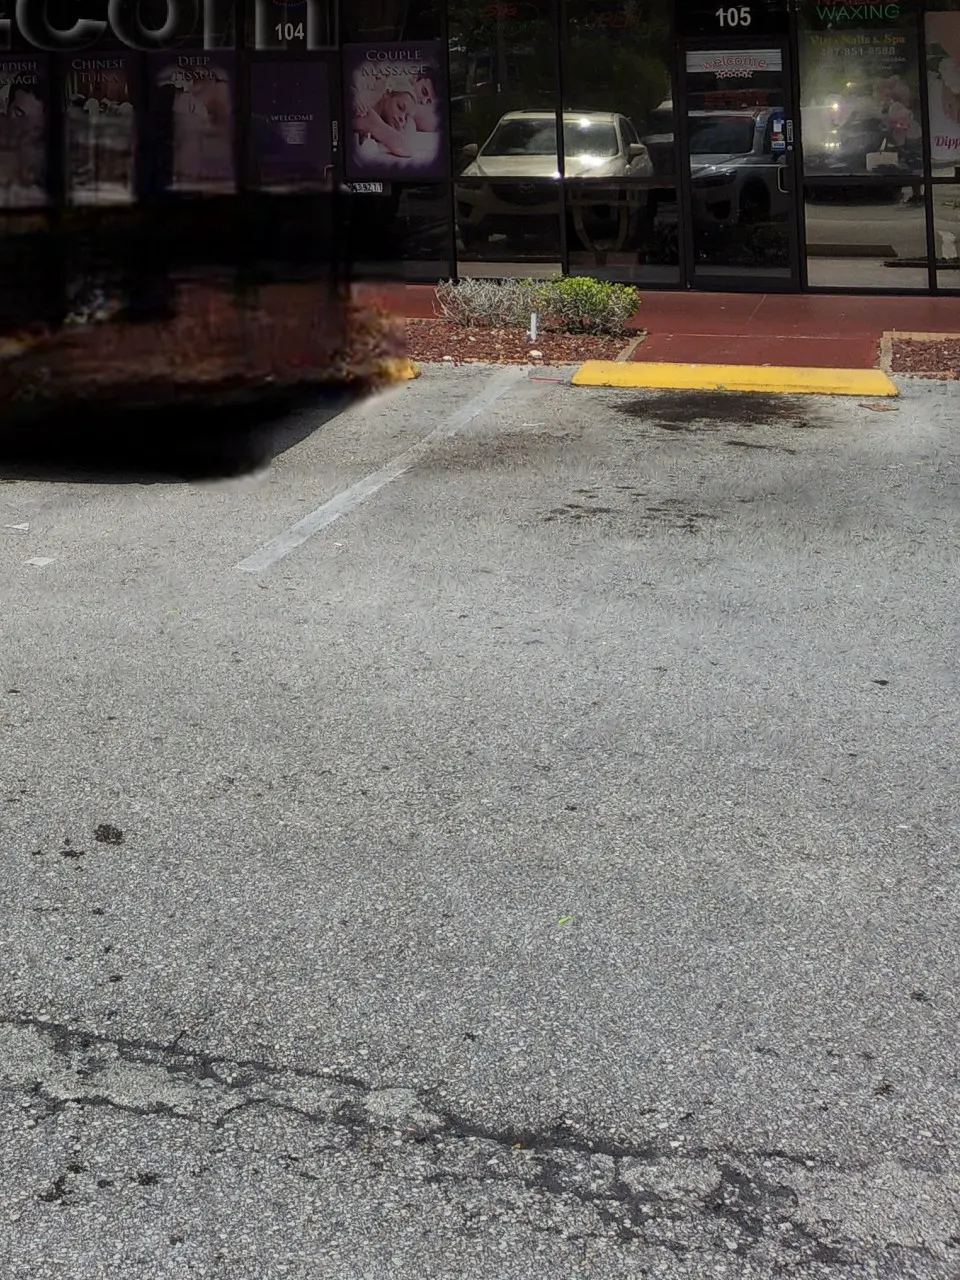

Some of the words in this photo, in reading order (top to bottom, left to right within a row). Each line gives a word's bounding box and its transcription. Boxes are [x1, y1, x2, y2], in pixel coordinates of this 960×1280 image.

[715, 7, 752, 27] 105
[816, 4, 900, 21] WAXING
[275, 22, 305, 41] 104
[883, 33, 906, 46] Spa
[178, 56, 210, 67] DEEP
[365, 49, 422, 62] COUPLE
[71, 59, 126, 70] CHINESE
[701, 55, 769, 70] welcome
[270, 113, 314, 122] WELCOME
